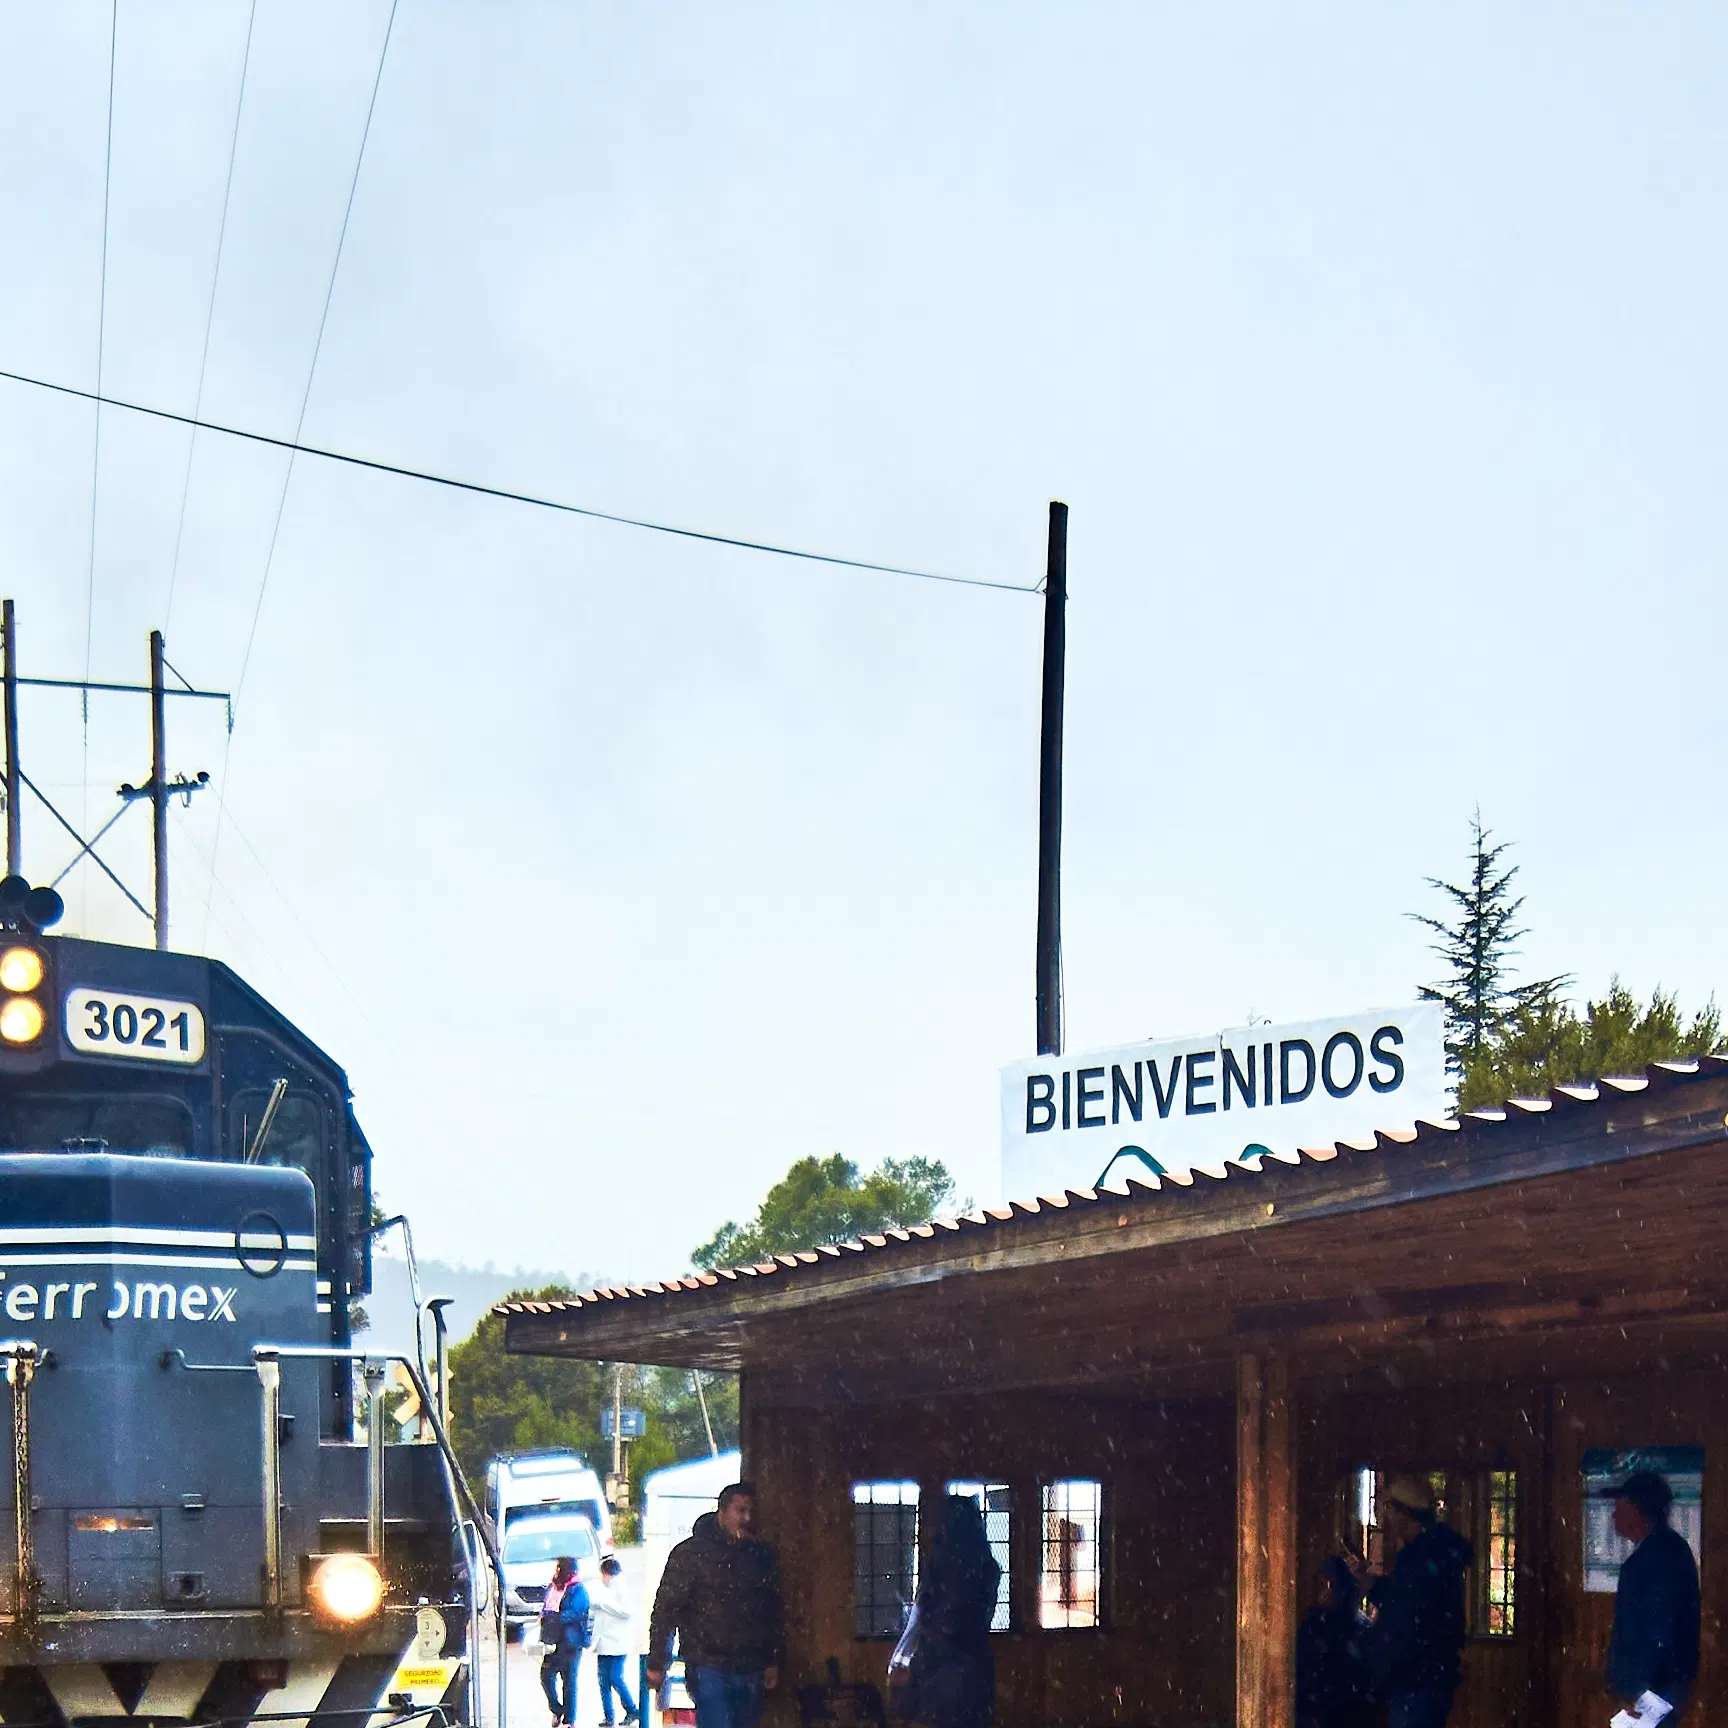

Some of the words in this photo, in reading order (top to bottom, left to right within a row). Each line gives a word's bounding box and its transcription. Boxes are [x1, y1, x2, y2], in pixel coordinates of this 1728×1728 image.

[84, 999, 190, 1052] 3021
[1025, 1025, 1405, 1135] BIENVENIDOS
[424, 1621, 430, 1631] 3
